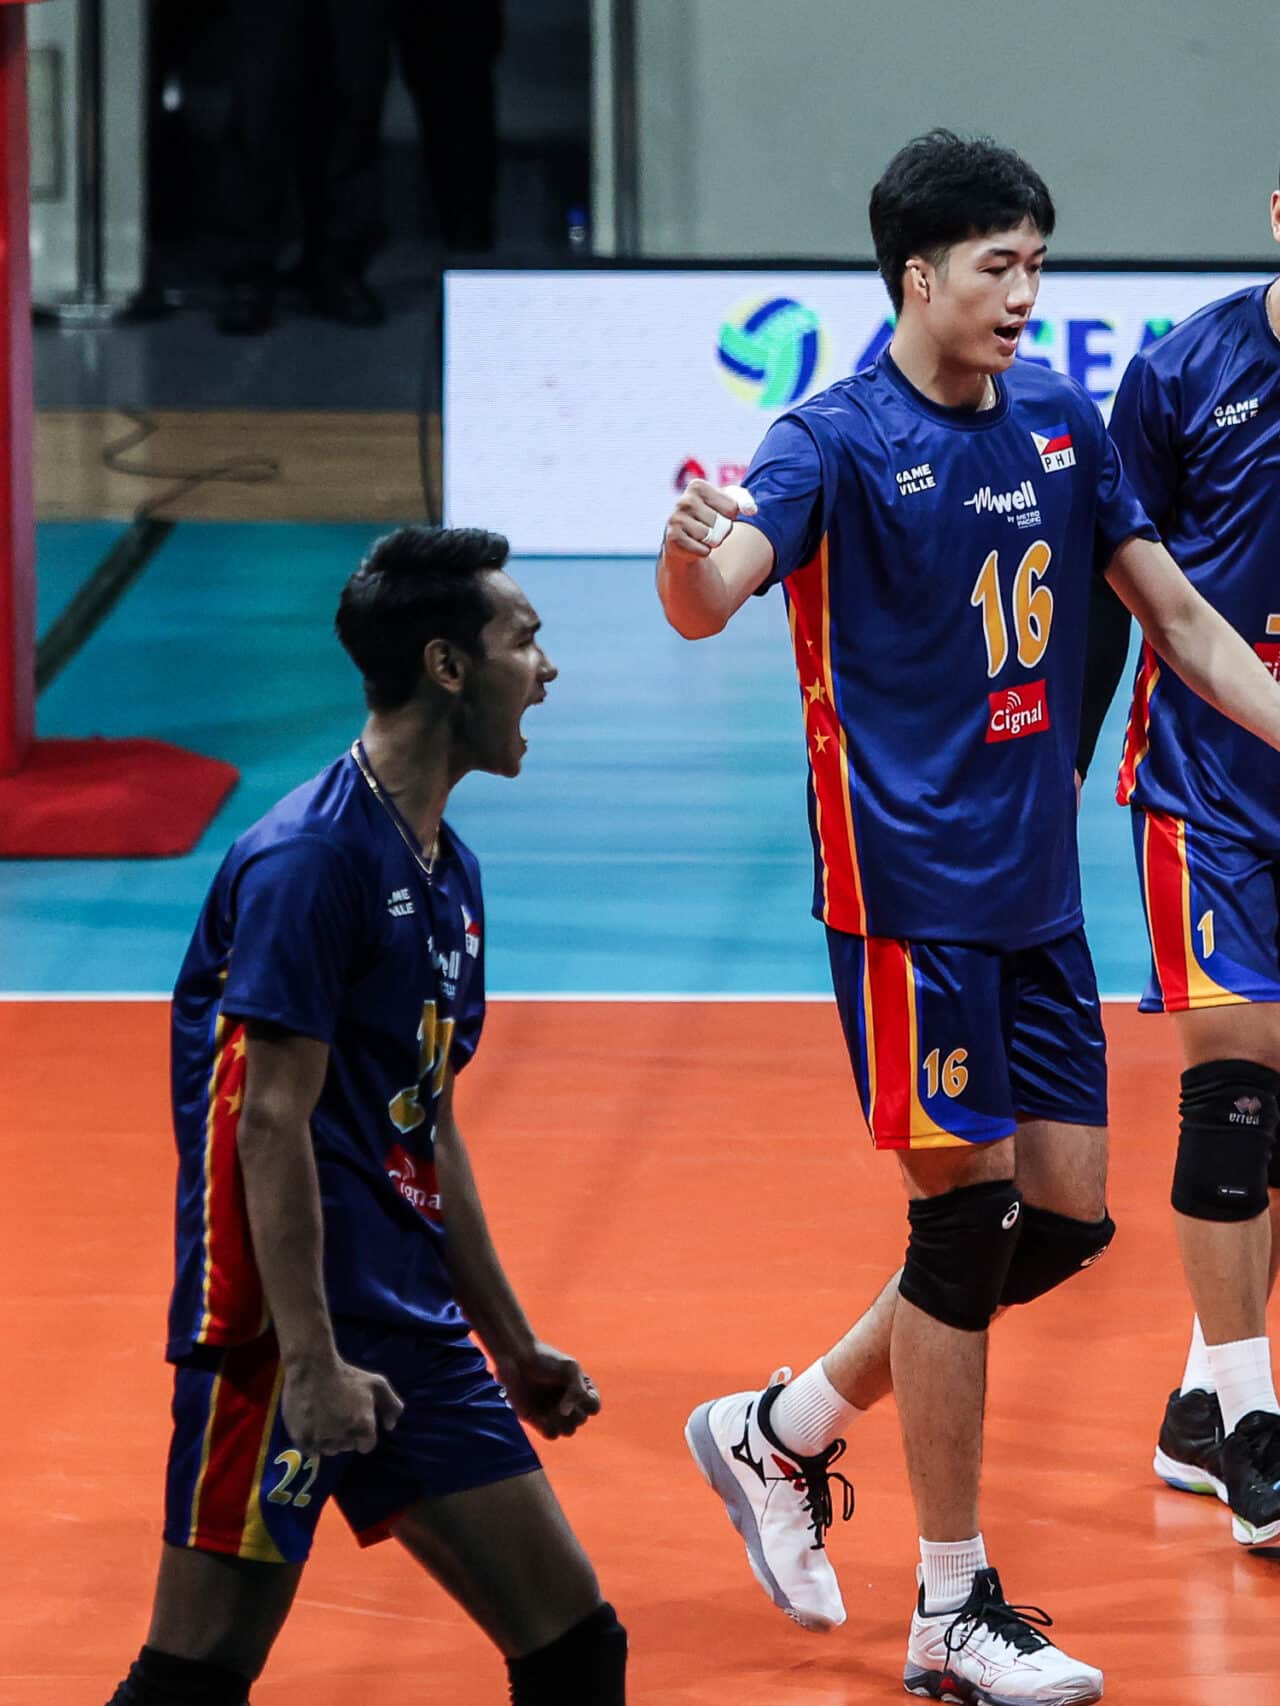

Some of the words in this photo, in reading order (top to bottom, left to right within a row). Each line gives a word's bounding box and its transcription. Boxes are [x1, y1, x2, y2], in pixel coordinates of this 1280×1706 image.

[1214, 398, 1259, 417] GAME
[896, 463, 932, 484] GAME
[1044, 450, 1073, 470] PHI
[899, 476, 937, 496] VILLE
[971, 540, 1055, 679] 16
[991, 701, 1042, 734] Cignal
[1197, 909, 1215, 960] 1
[922, 1047, 969, 1099] 16
[266, 1449, 321, 1508] 22
